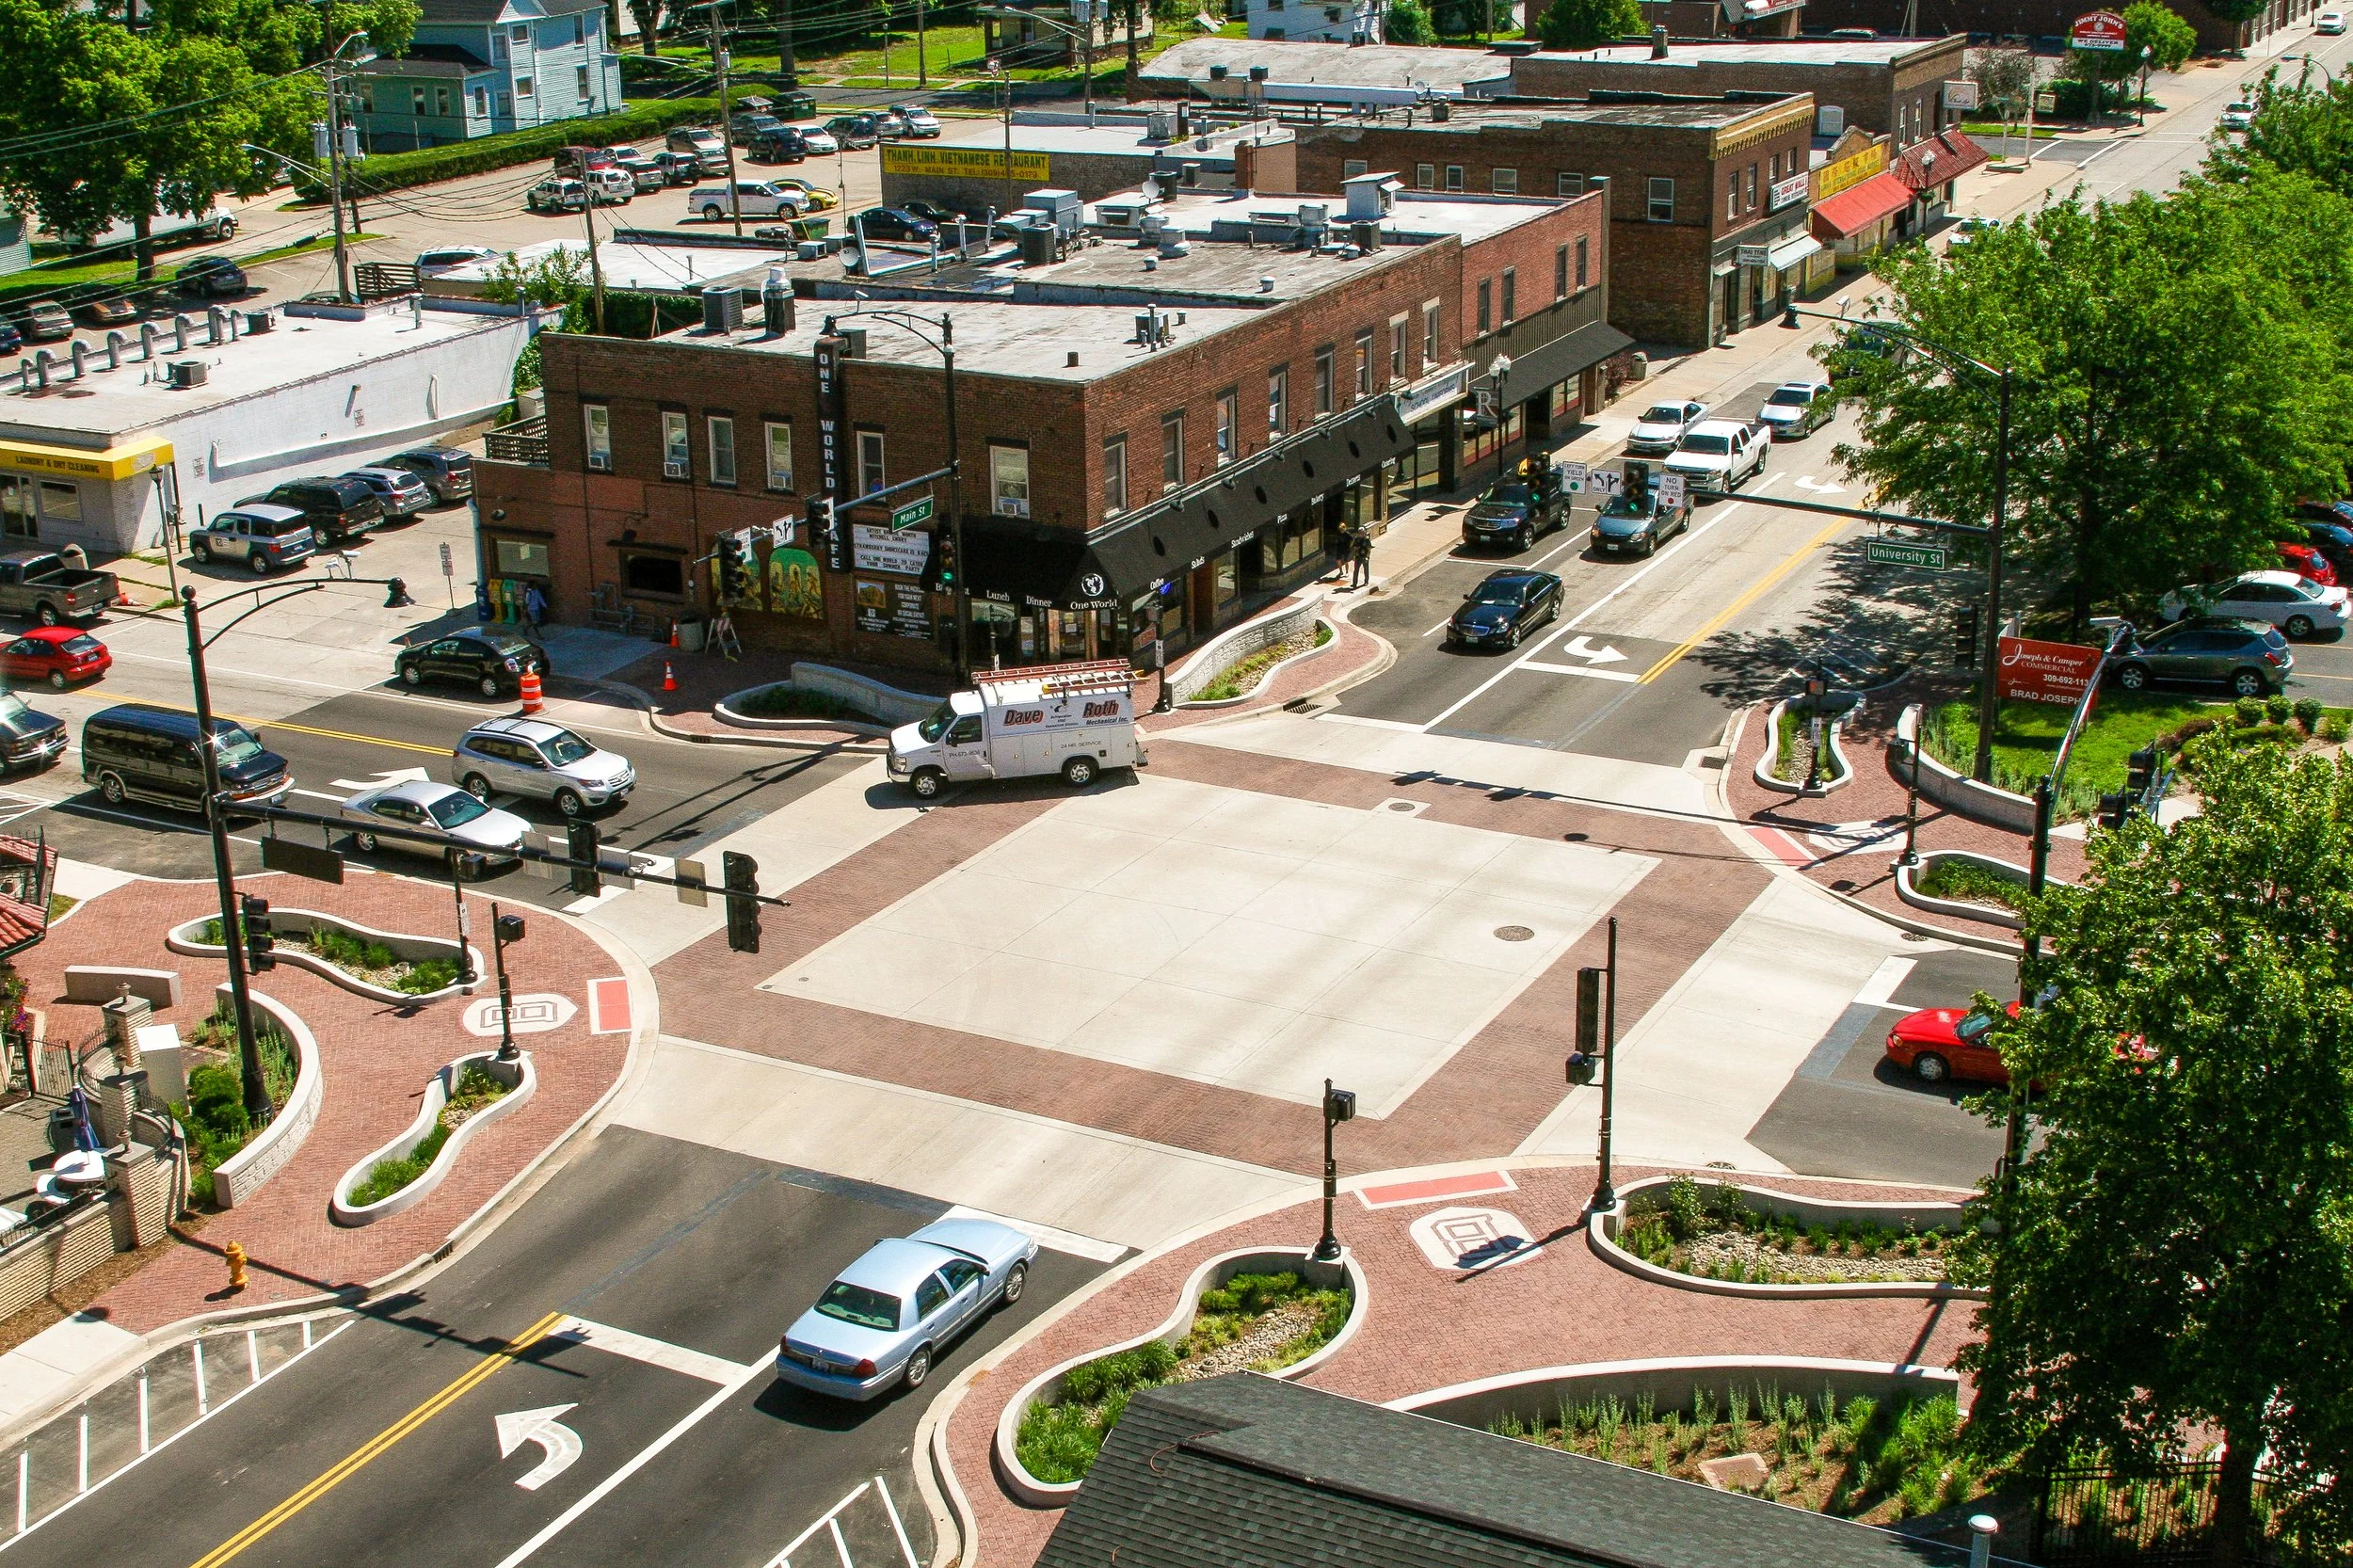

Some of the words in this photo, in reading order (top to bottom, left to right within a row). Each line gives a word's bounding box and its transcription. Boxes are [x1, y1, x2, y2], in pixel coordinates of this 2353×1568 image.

[2074, 16, 2098, 27] JIMMY
[2099, 15, 2124, 29] JOHN'S
[941, 152, 989, 167] VIETNAMESE
[993, 153, 1047, 169] RETAURANT
[925, 166, 944, 174] MAIN
[1781, 183, 1795, 196] GREAT
[819, 353, 830, 393] ONE
[821, 420, 836, 488] WORLD
[16, 456, 44, 467] LAUNDRY
[54, 459, 66, 471] DRY
[68, 460, 101, 473] CLEANING
[900, 509, 917, 524] Main
[919, 505, 925, 517] St
[1231, 530, 1255, 549] Sandwiches
[854, 542, 883, 552] STRAWBERRY
[1871, 547, 1926, 565] University
[1929, 553, 1941, 565] St
[905, 565, 920, 573] PARTY
[1150, 578, 1164, 590] Coffee
[985, 589, 1010, 602] Lunch
[1025, 595, 1052, 608] Dinner
[1069, 600, 1090, 610] One
[1090, 599, 1117, 609] World
[2002, 644, 2042, 666] Joseph
[2053, 655, 2084, 666] Camper
[2021, 661, 2077, 675] COMMERCIAL
[2010, 688, 2040, 700] BRAD
[2041, 693, 2083, 705] JOSEPH
[1003, 708, 1045, 727] Dave
[1082, 699, 1119, 719] Roth
[1085, 717, 1117, 726] Mechanical
